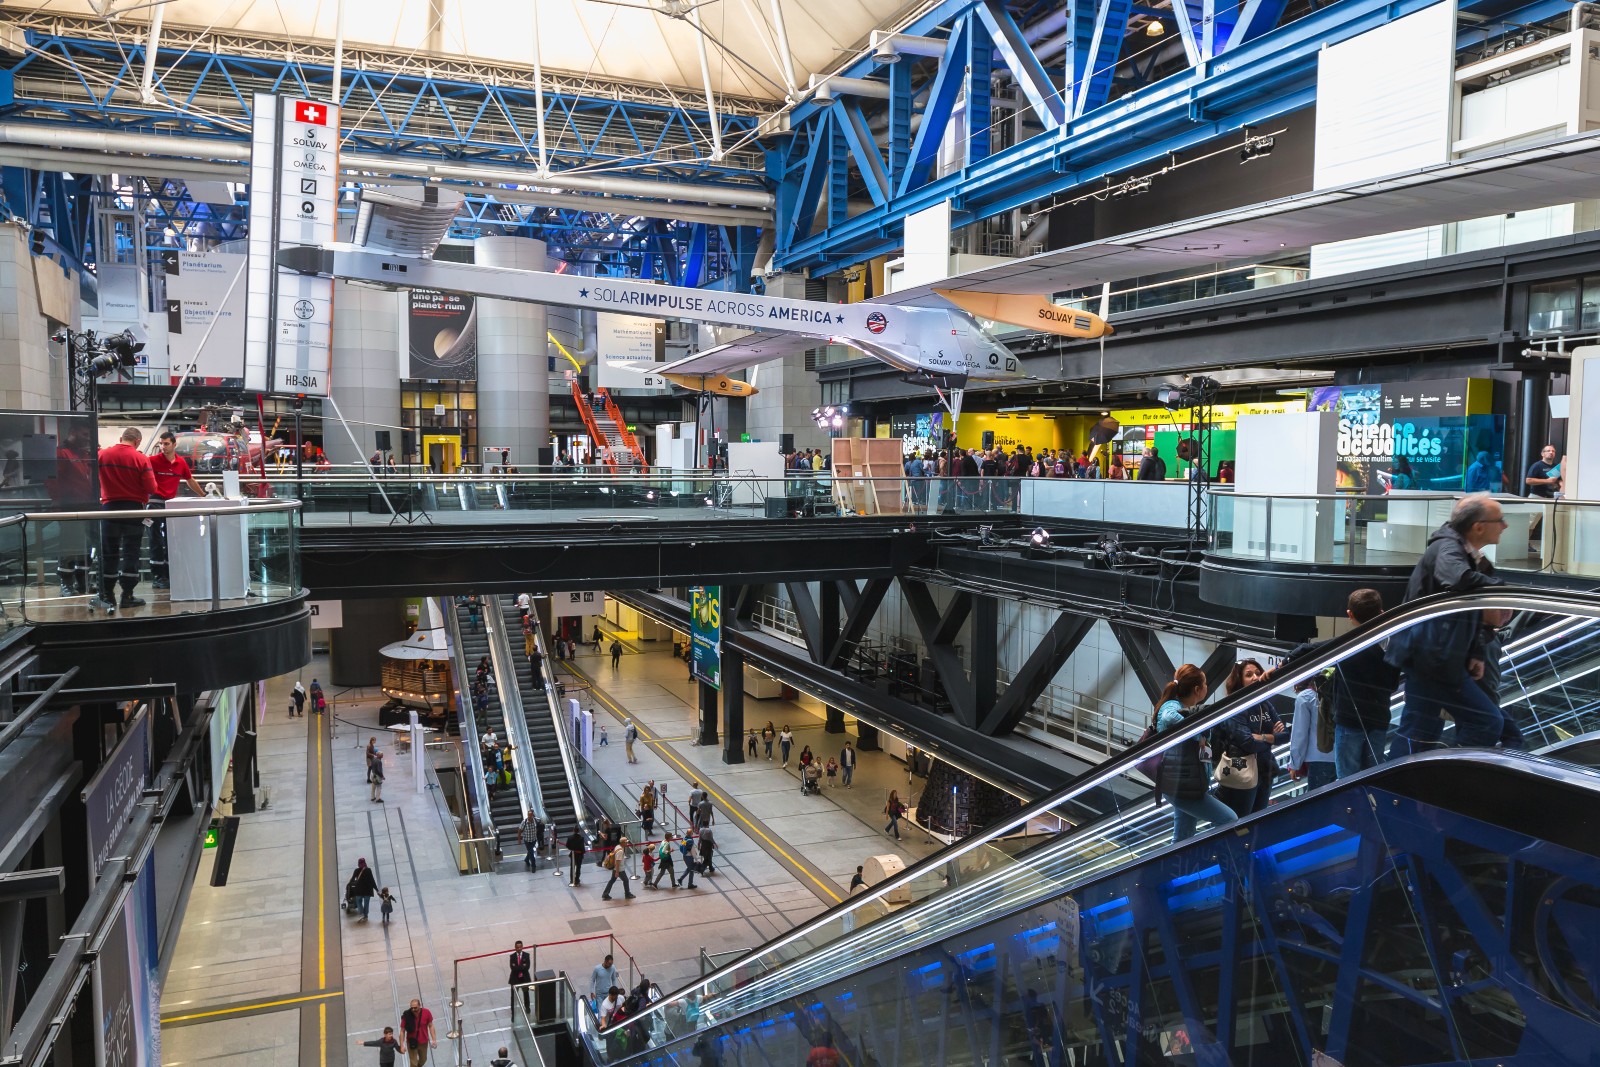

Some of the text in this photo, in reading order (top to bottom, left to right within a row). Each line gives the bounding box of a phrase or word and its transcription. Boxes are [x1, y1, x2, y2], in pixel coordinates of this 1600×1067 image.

[293, 138, 327, 149] SOLVAY
[293, 160, 326, 171] OMEGA
[593, 287, 832, 324] SOLARIMPULSE ACROSS AMERICA
[1038, 309, 1073, 324] SOLVAY
[285, 374, 317, 388] HB-SIA
[1337, 413, 1416, 440] Science
[1336, 428, 1442, 456] actualités
[1343, 455, 1371, 463] magazine
[106, 789, 115, 823] LA
